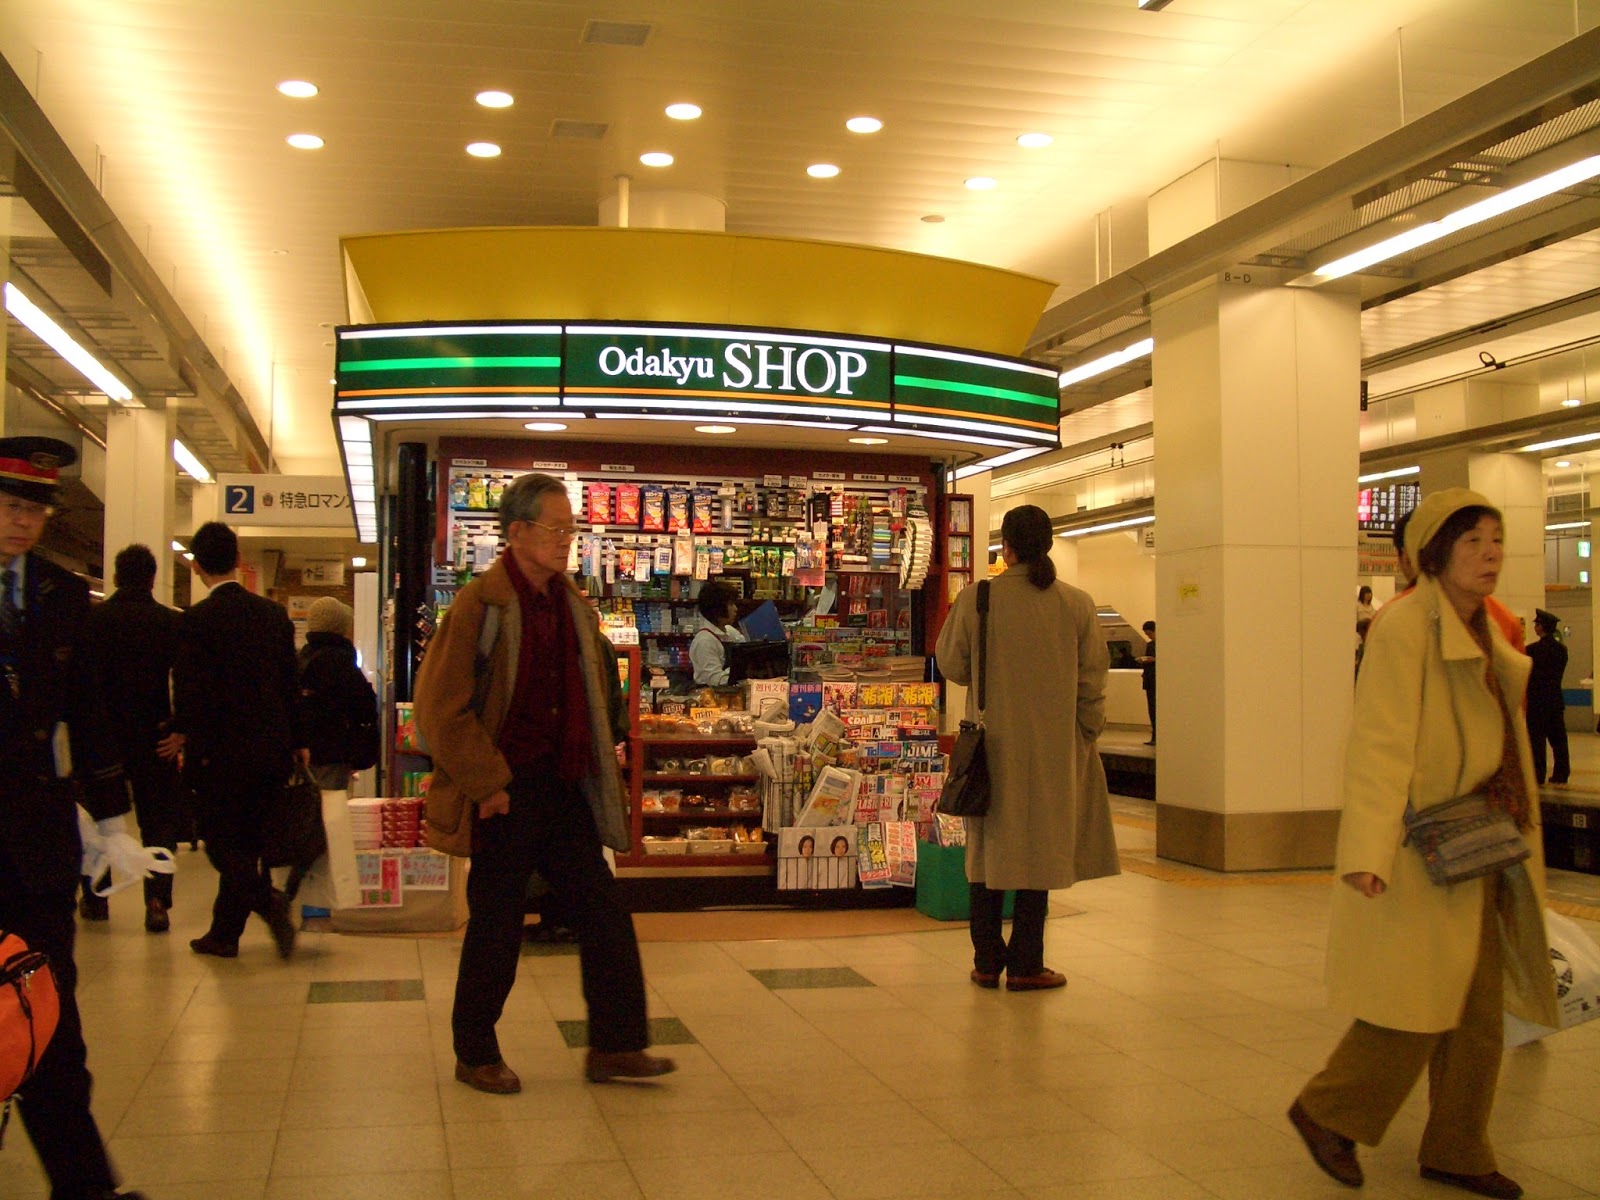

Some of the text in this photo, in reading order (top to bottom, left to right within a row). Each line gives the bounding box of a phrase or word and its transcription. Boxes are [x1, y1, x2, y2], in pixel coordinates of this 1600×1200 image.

[598, 343, 868, 395] Odakyu SHOP
[231, 488, 248, 512] 2
